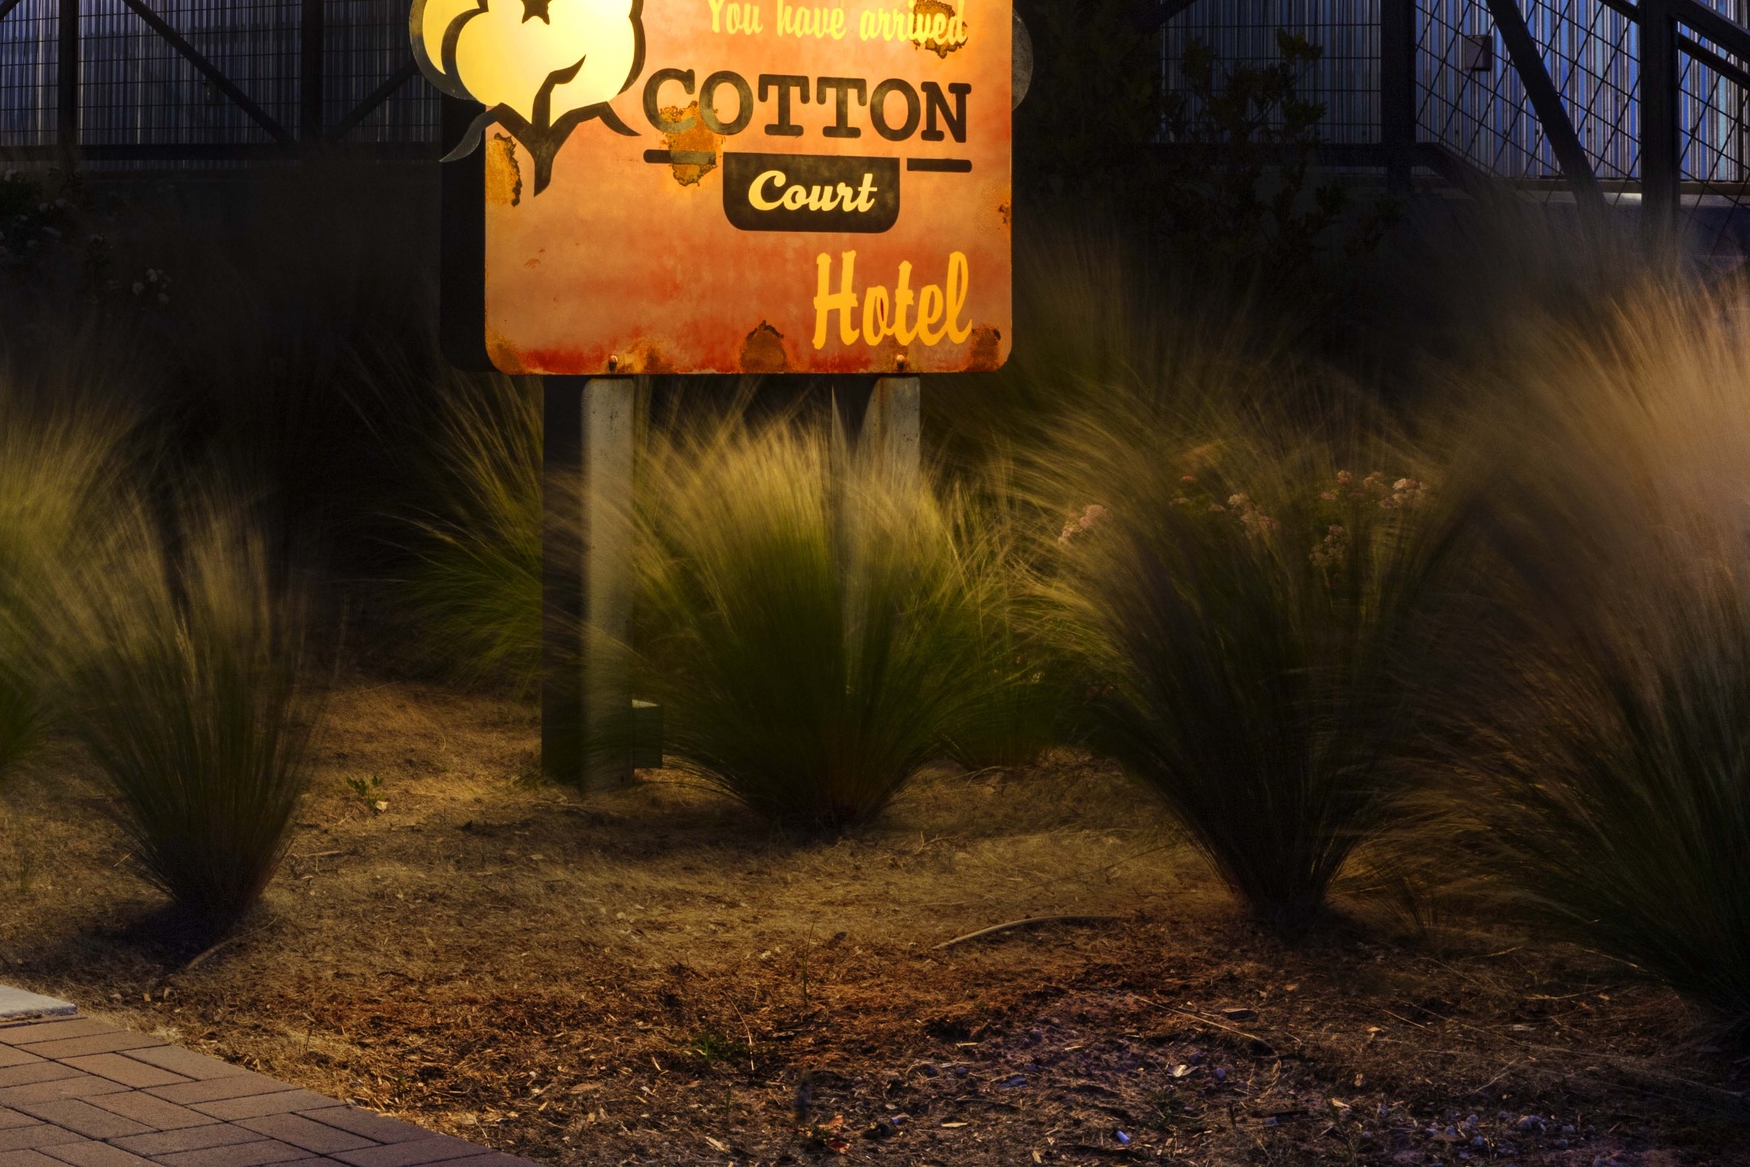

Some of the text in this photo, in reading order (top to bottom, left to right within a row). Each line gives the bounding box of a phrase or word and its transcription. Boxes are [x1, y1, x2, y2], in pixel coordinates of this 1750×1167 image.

[642, 68, 972, 144] COTTON
[748, 170, 877, 213] Court
[812, 250, 973, 350] Hotel
